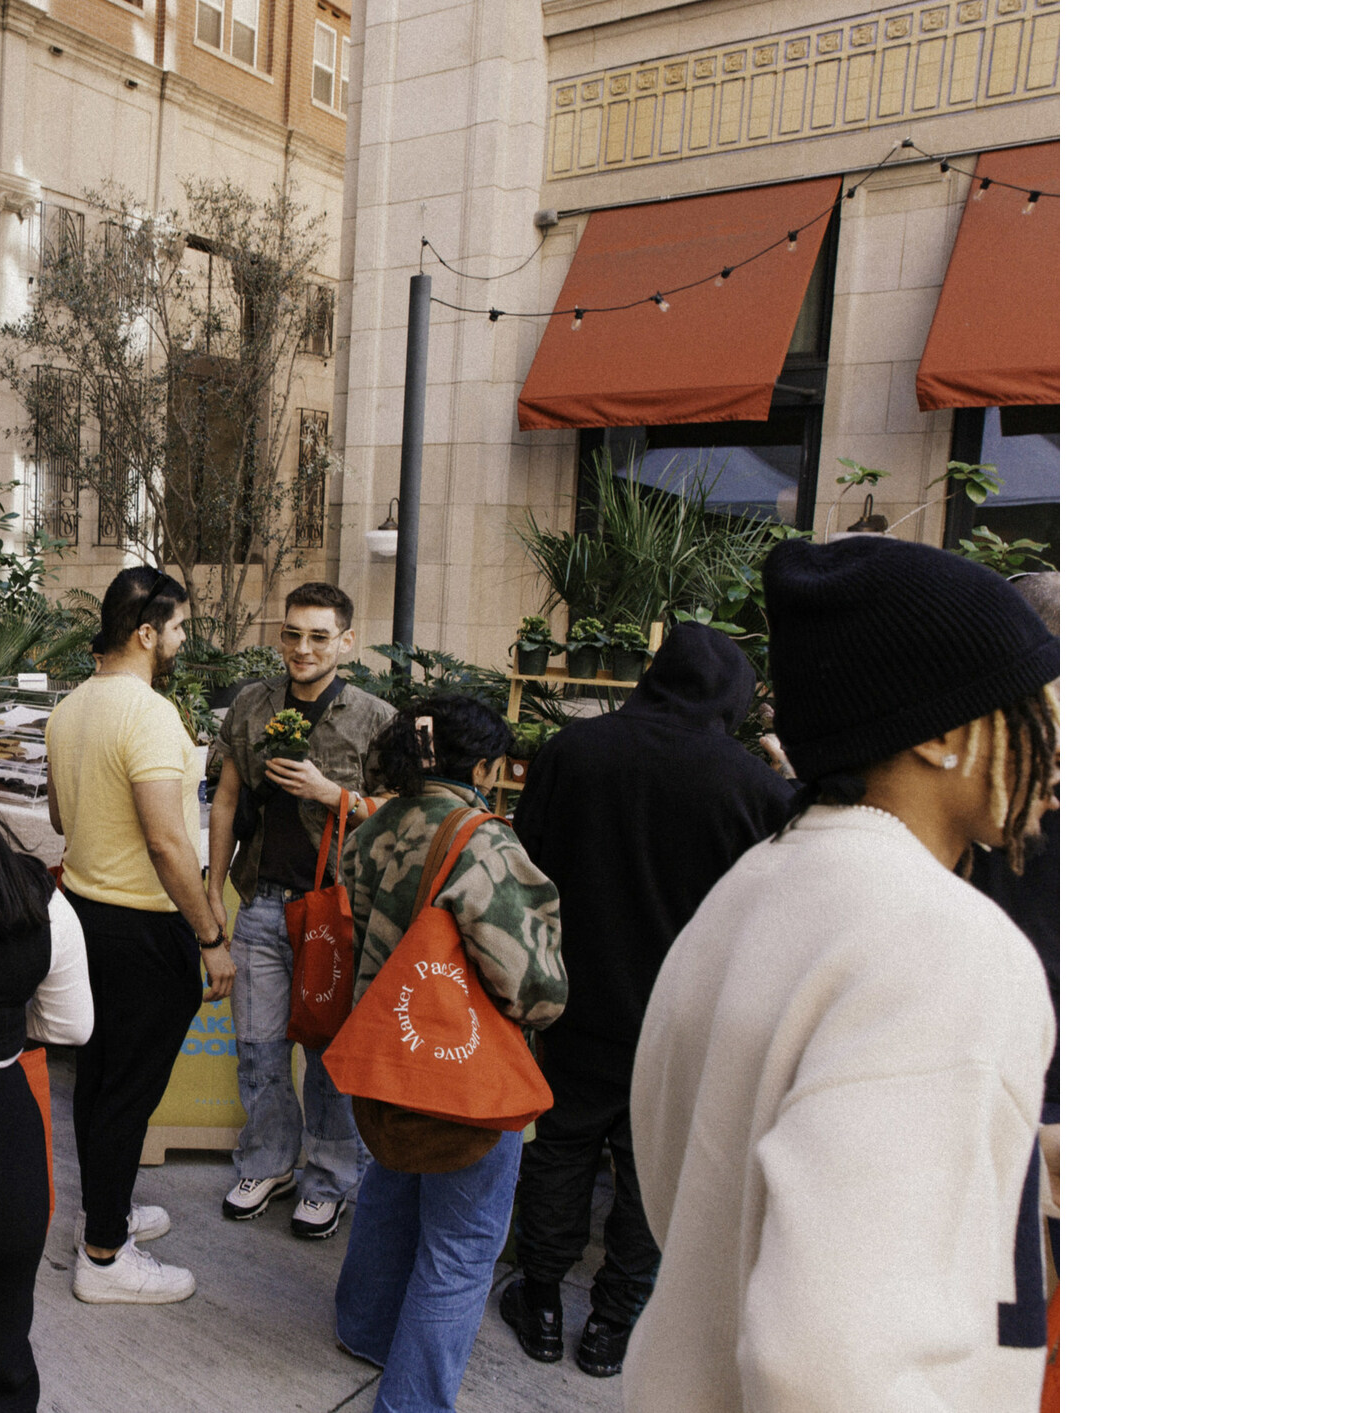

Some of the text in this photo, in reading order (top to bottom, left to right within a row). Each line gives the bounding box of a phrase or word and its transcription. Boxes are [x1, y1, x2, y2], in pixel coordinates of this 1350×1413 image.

[393, 961, 480, 1064] PacSun Collective Market
